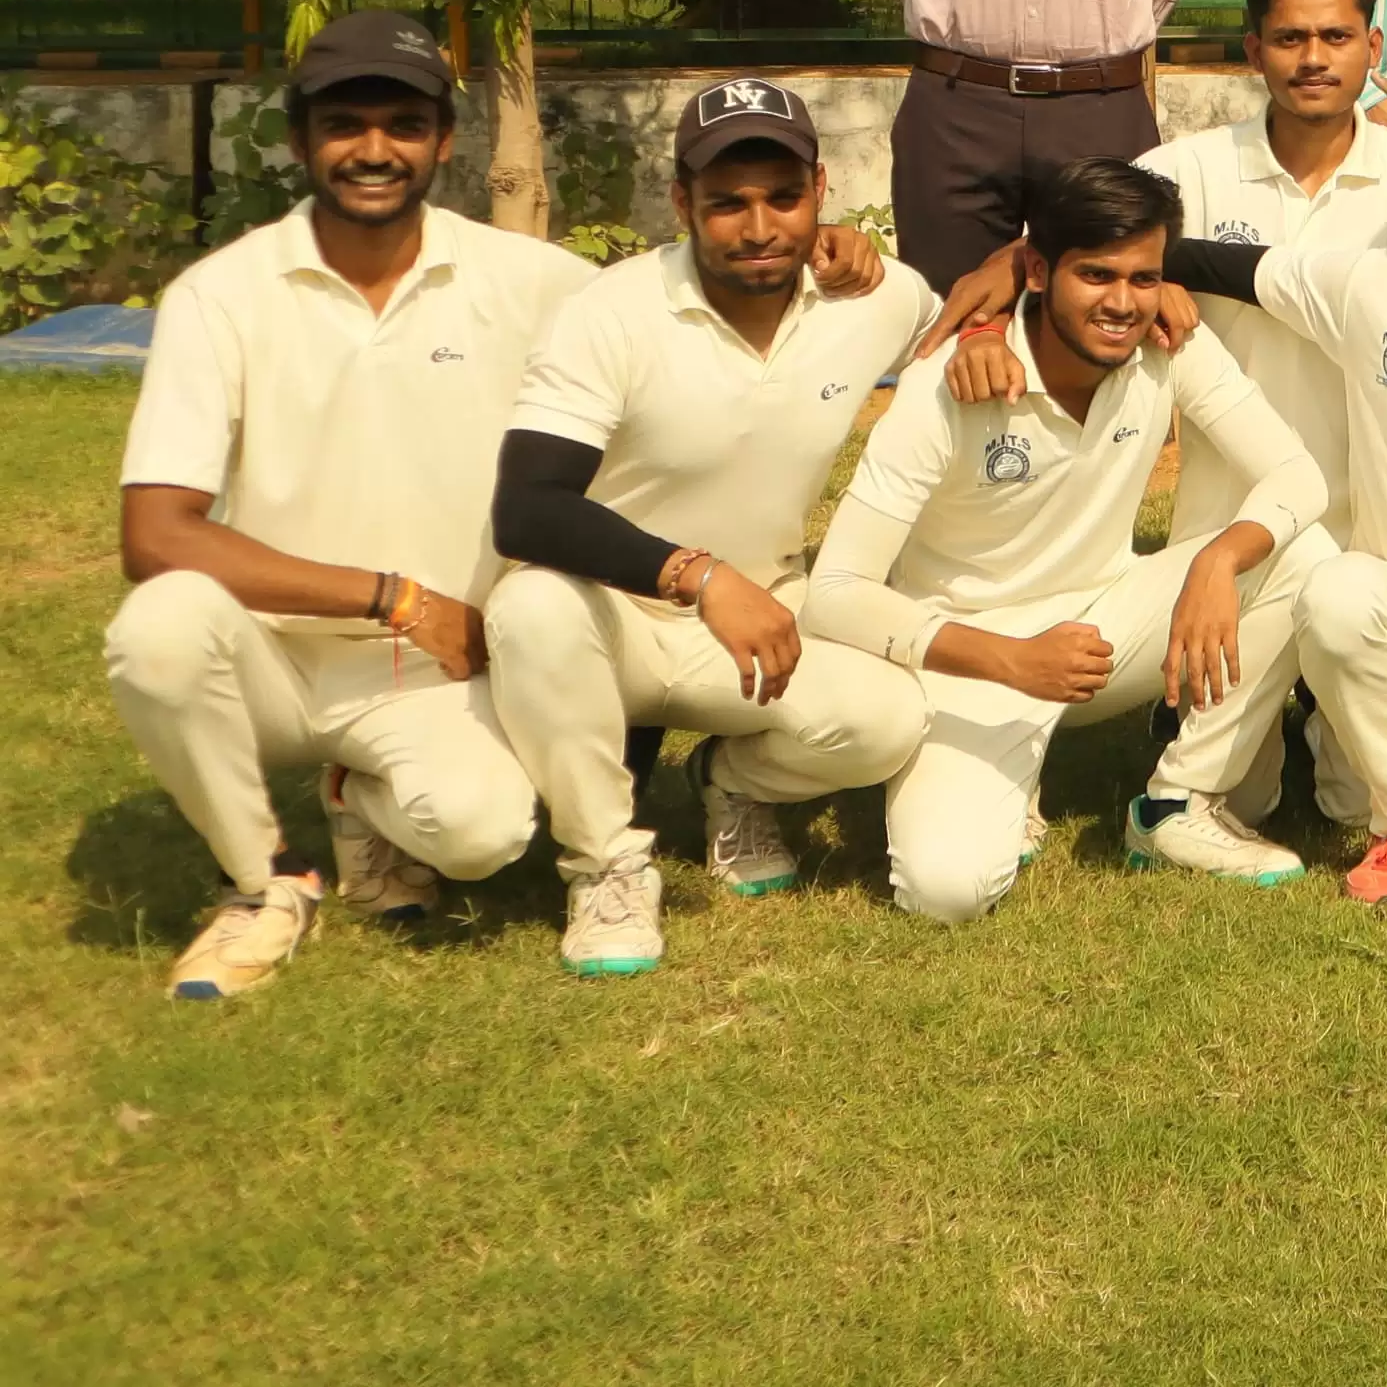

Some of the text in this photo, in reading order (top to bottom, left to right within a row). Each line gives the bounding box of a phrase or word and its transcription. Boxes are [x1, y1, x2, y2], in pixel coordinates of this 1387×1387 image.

[723, 81, 767, 110] NY
[1214, 219, 1260, 243] M.I.T.S
[984, 433, 1032, 458] M.I.T.S
